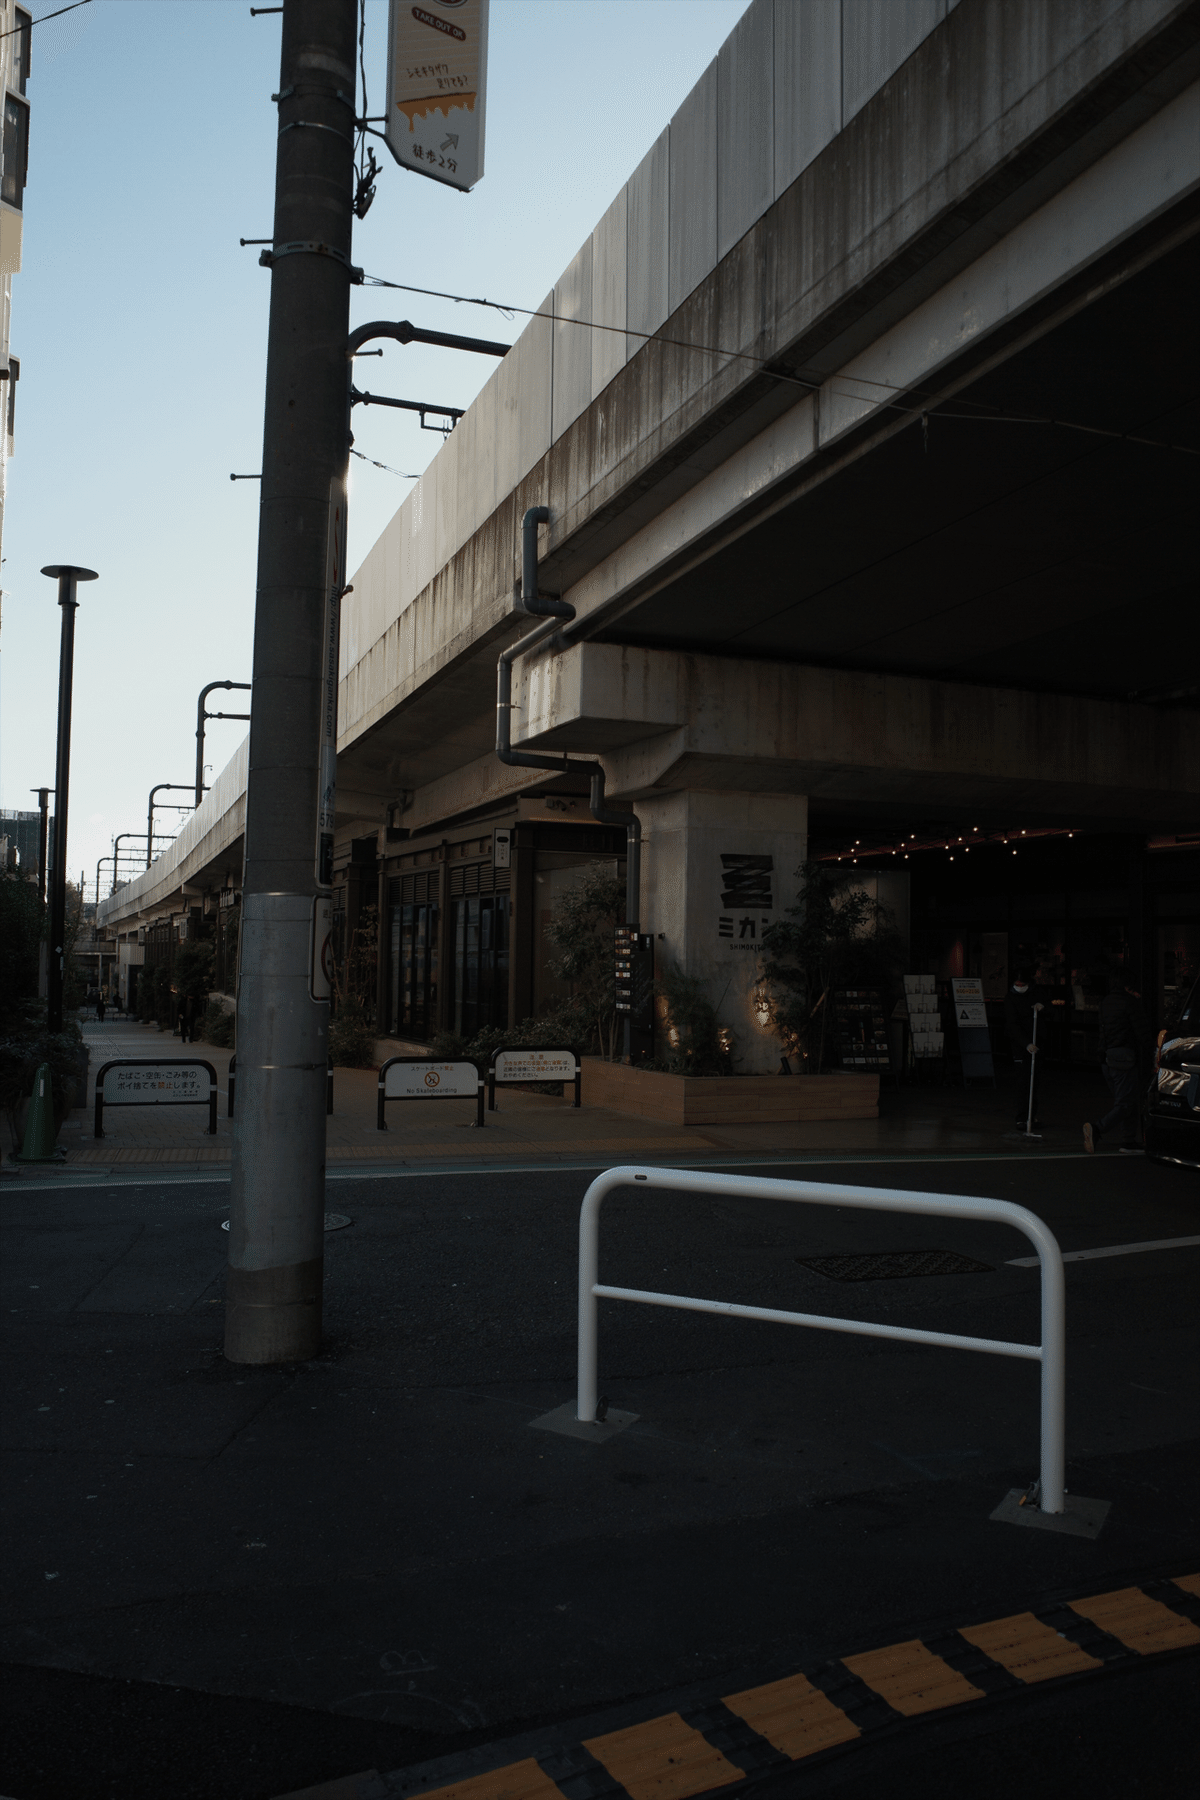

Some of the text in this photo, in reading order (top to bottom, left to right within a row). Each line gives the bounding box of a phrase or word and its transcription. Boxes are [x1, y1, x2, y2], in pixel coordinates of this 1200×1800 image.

[414, 9, 464, 40] TAKE OUT OK
[412, 143, 458, 174] 徒歩2分
[326, 585, 338, 738] http://www.sasakiganka.com
